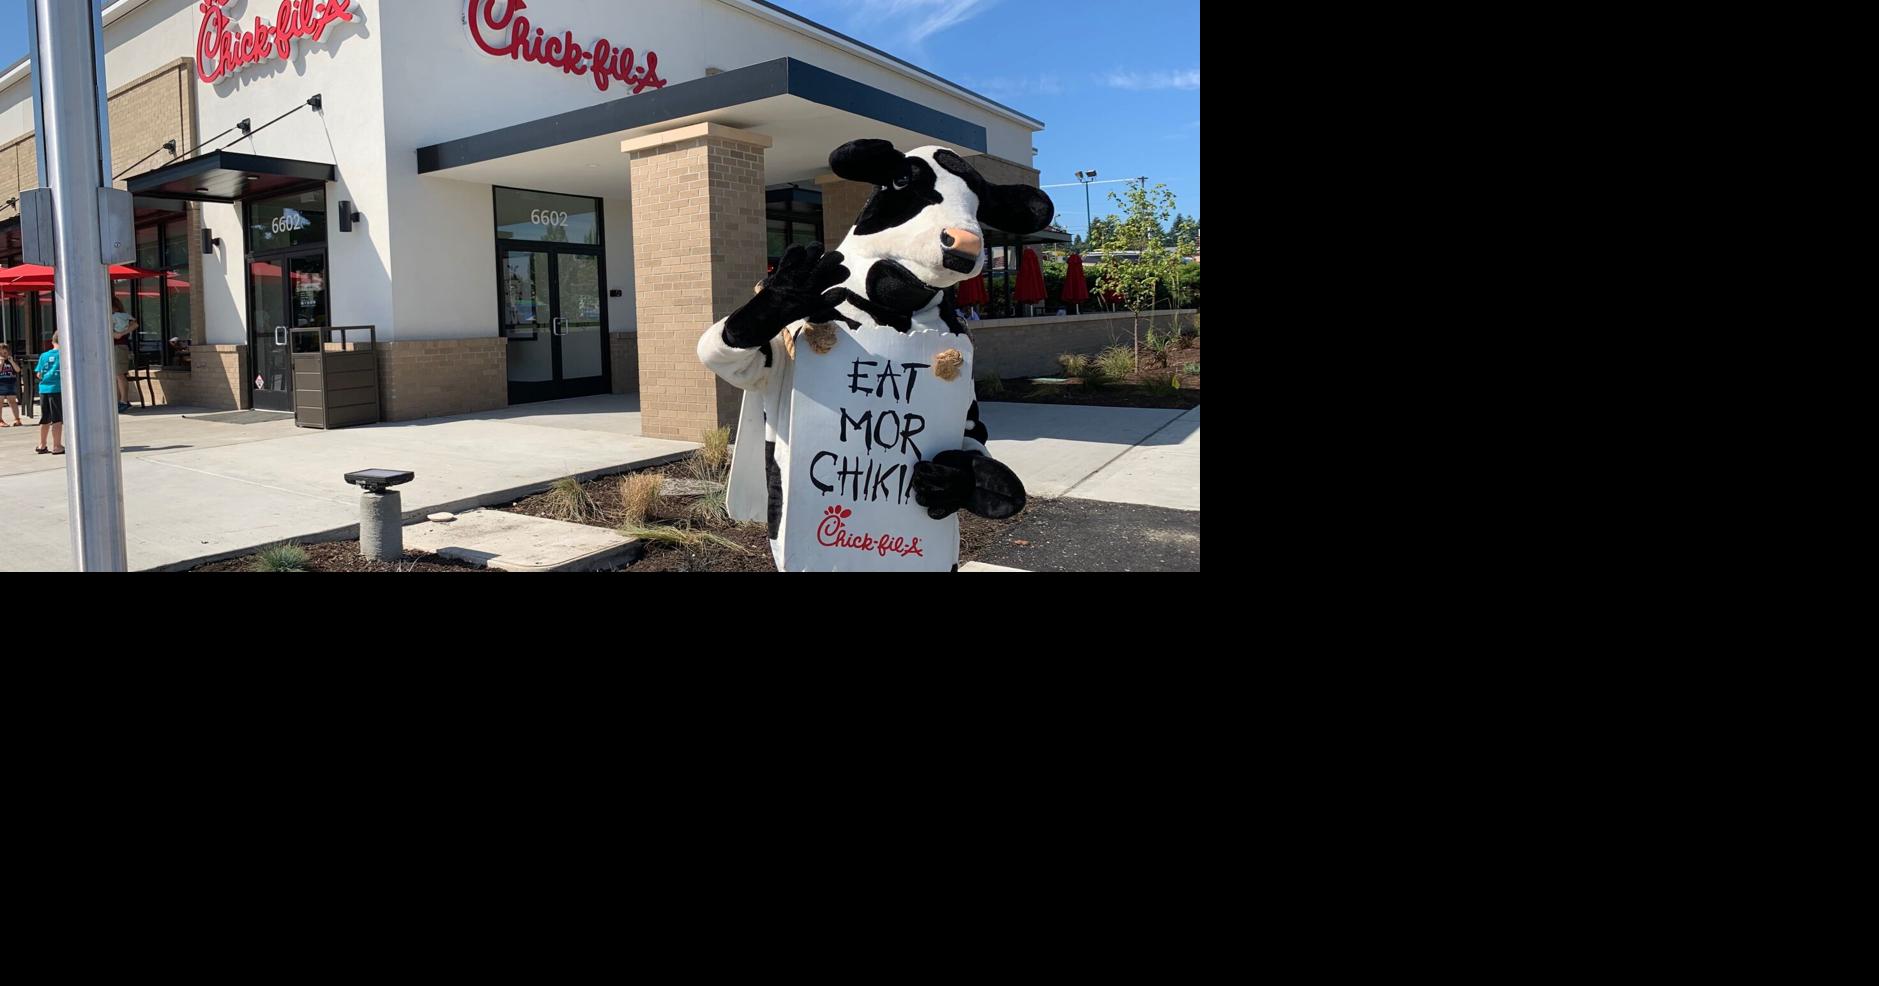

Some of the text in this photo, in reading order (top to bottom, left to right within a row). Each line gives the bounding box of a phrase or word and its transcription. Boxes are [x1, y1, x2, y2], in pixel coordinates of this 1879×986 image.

[197, 0, 352, 83] Chick-fil-A
[468, 0, 667, 94] Chick-fil-A
[271, 213, 301, 234] 6602
[530, 208, 569, 228] 6602
[847, 357, 930, 404] EAT
[839, 407, 923, 461] MOR
[817, 514, 923, 557] Chick-fil-A
